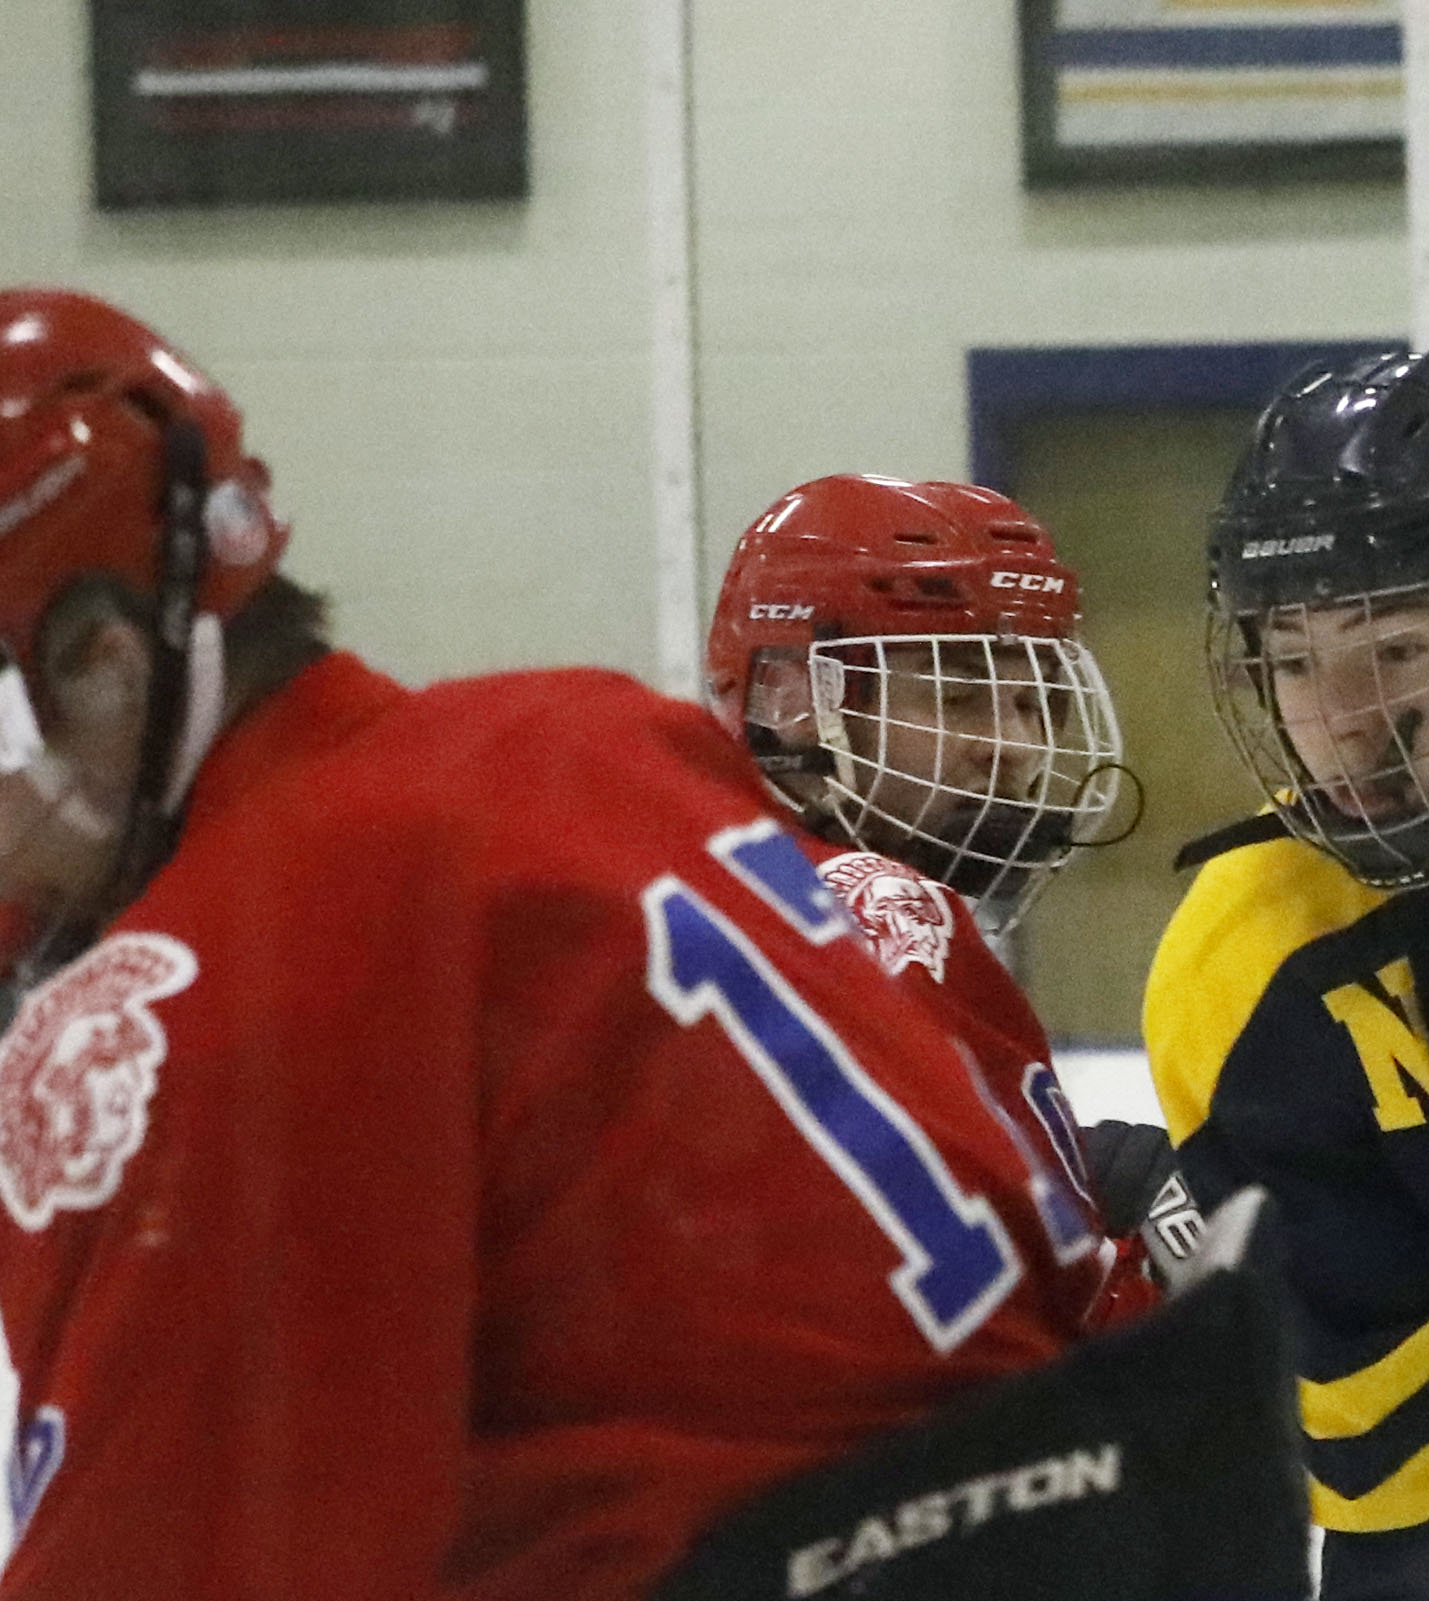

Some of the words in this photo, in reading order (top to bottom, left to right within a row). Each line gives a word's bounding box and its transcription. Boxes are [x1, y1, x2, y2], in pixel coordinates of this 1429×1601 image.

[989, 570, 1066, 595] CCM
[748, 603, 815, 621] CCM
[786, 1441, 1122, 1600] EASTON
